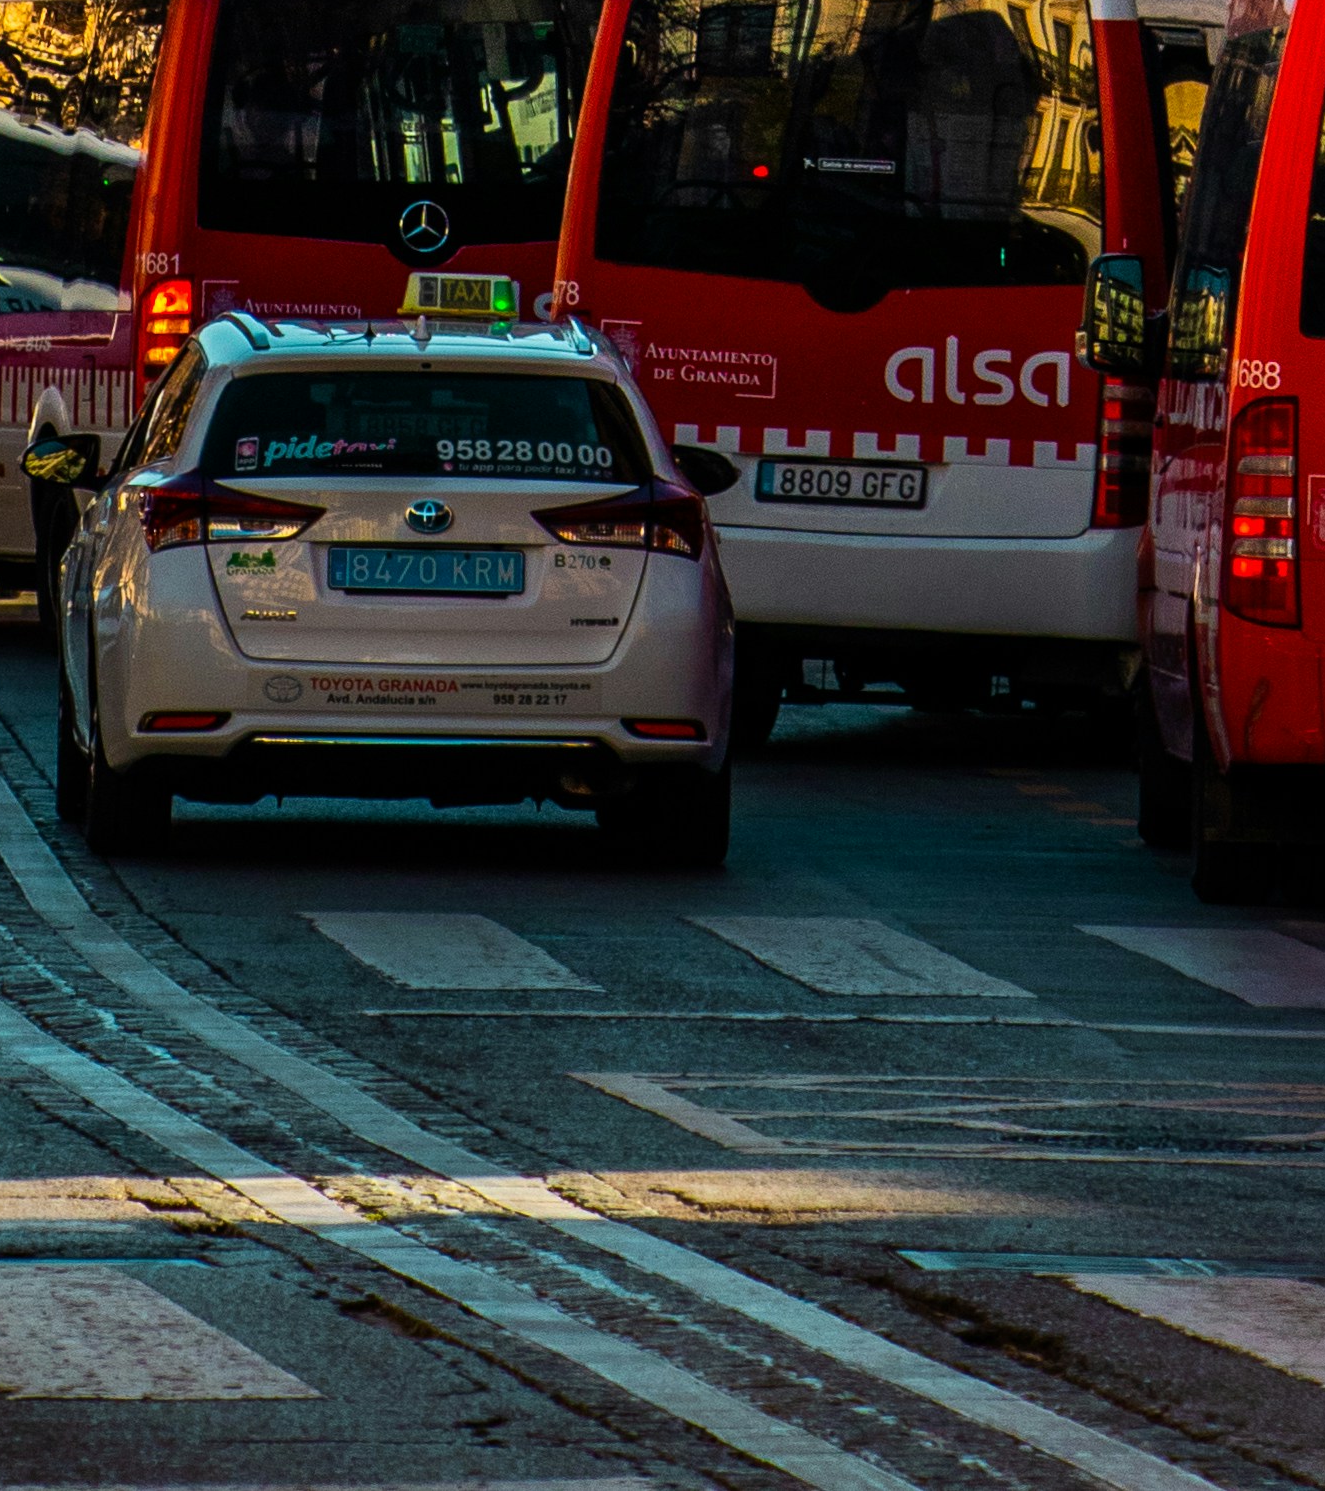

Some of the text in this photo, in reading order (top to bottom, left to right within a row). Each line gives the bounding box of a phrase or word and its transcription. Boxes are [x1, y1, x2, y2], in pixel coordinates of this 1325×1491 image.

[443, 279, 490, 302] TAXI
[884, 334, 1072, 409] alsa
[436, 439, 613, 468] 958 28 00 00
[472, 463, 494, 473] app
[554, 465, 576, 474] taxi
[779, 468, 917, 500] 8809 GFG
[351, 554, 516, 586] 8470 KRM
[310, 676, 374, 692] TOYOTA
[378, 678, 460, 693] GRANADA
[327, 693, 353, 705] Avd.
[418, 694, 436, 705] s/n
[493, 693, 515, 705] 958
[536, 693, 551, 705] 22
[554, 693, 568, 705] 17
